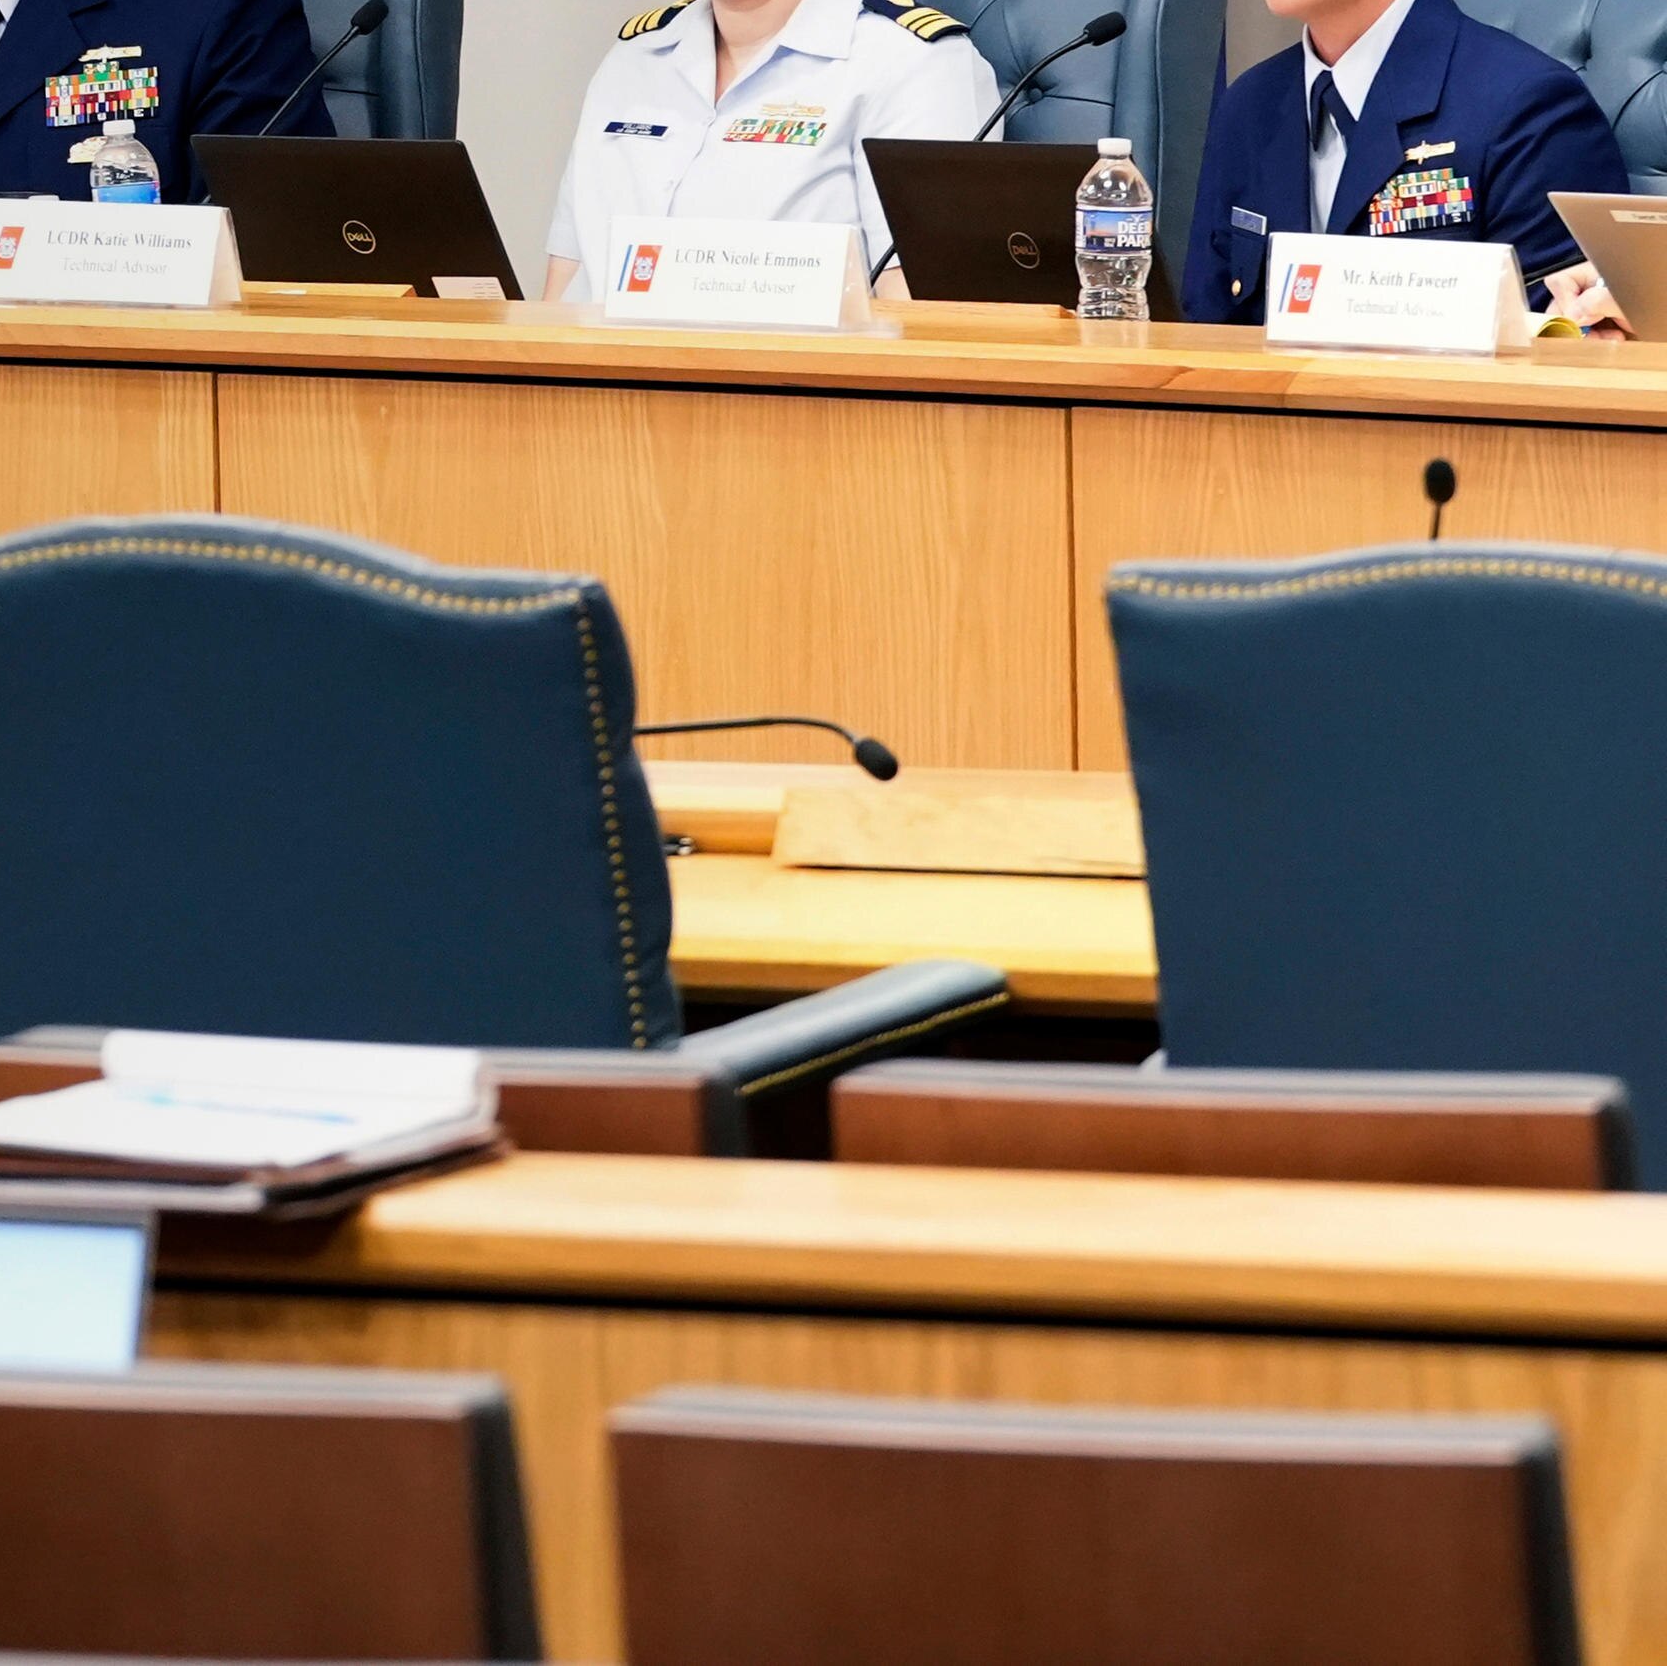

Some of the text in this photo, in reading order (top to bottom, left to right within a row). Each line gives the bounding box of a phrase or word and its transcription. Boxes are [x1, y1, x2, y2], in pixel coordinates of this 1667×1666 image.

[47, 230, 193, 249] LCDR Katie Williams
[675, 249, 821, 268] LCDR Nicole Emmons
[1369, 271, 1403, 287] Keith
